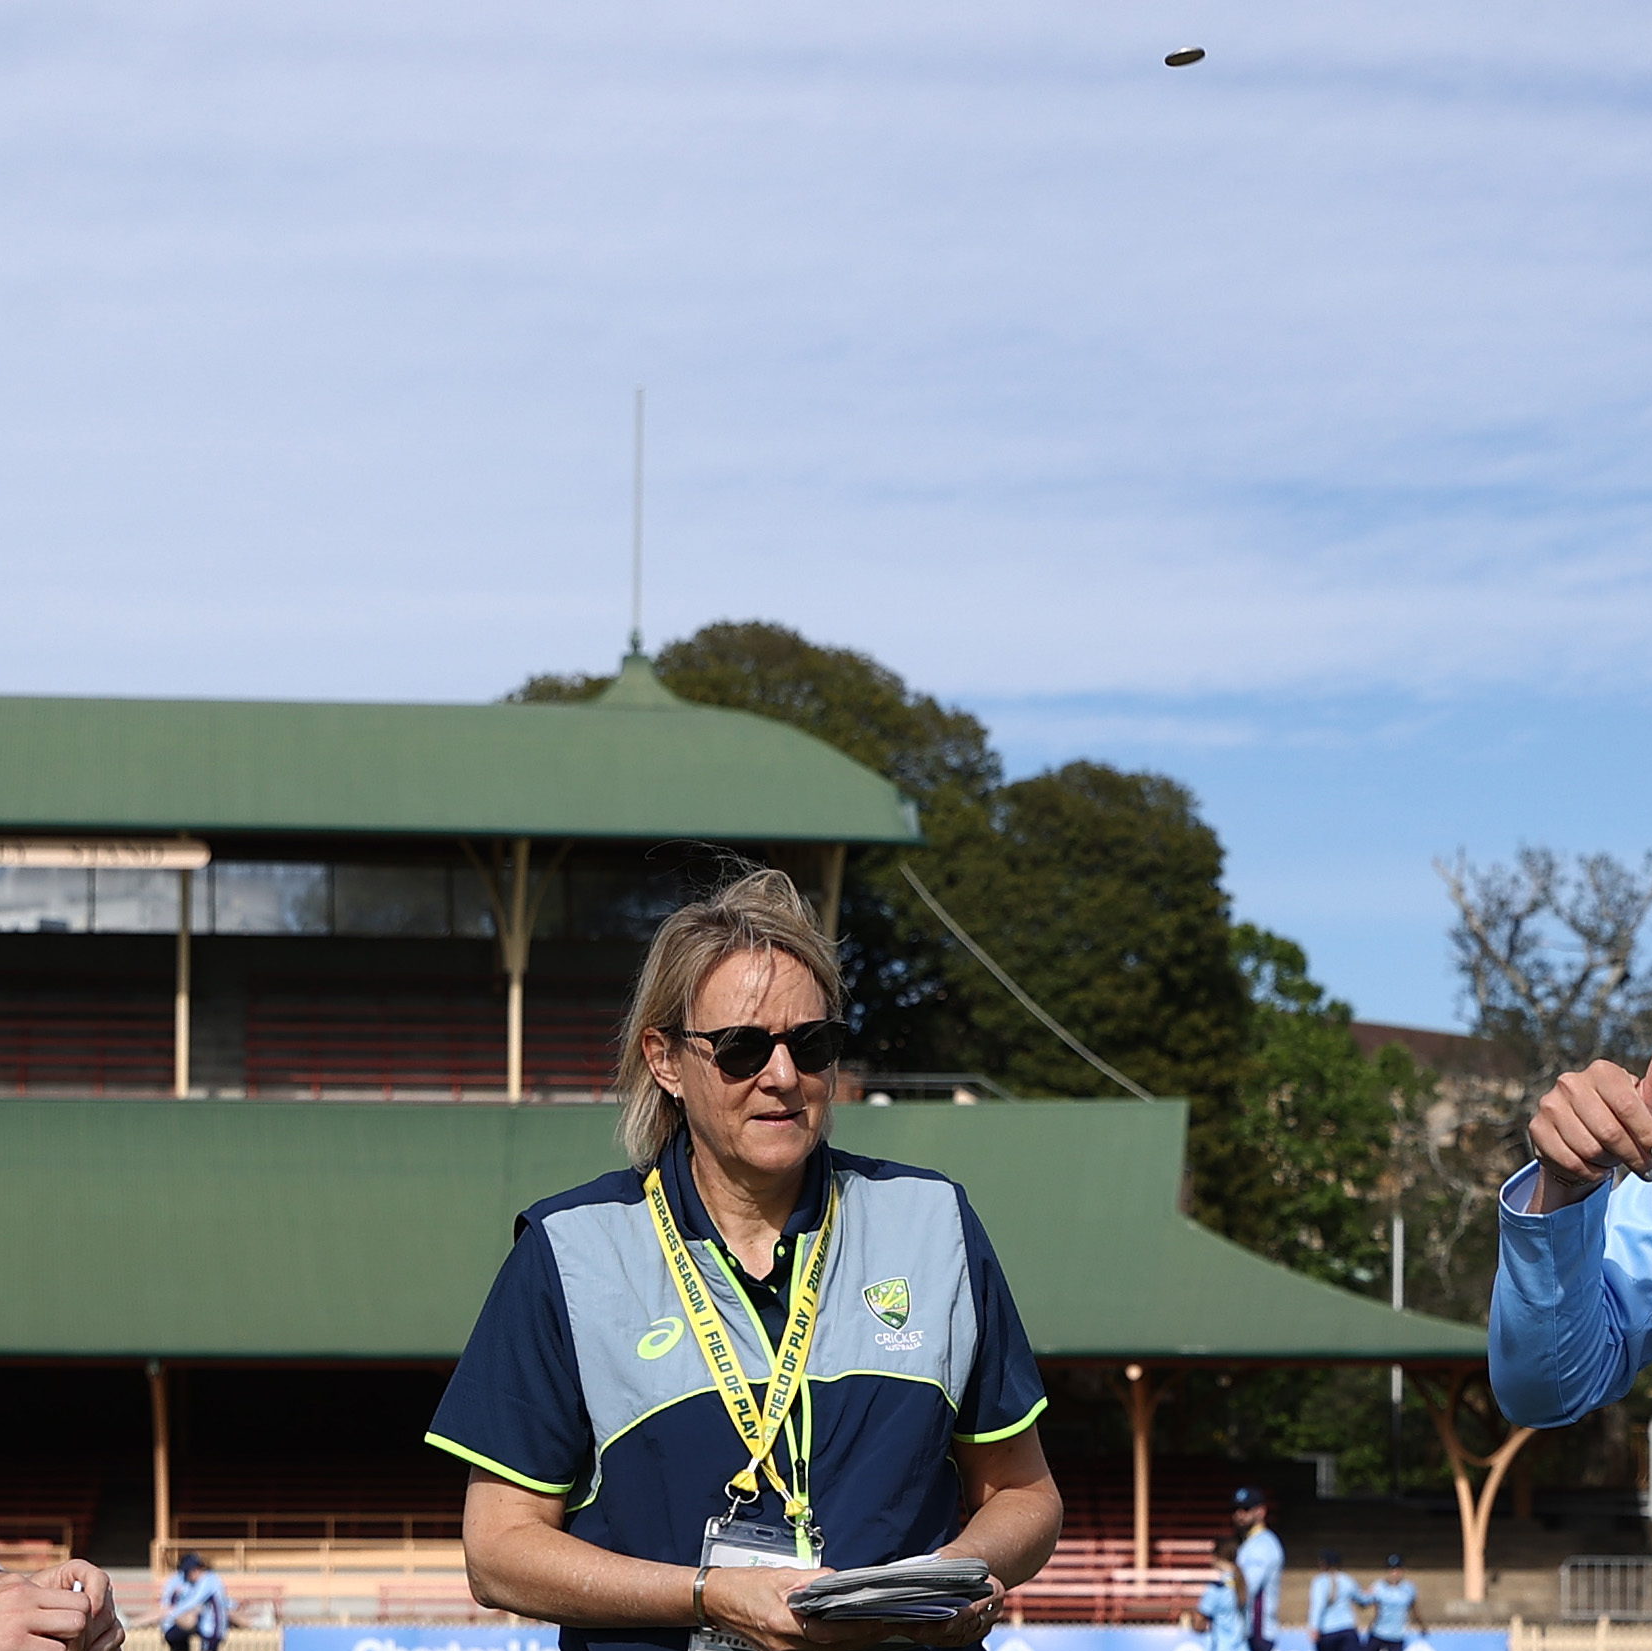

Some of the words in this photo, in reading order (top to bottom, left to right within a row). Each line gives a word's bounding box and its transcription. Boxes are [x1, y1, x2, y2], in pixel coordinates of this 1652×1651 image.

[674, 1252, 707, 1314] SEASON
[788, 1307, 810, 1350] PLAY
[875, 1330, 924, 1345] CRICKET
[705, 1330, 733, 1373] FIELD
[781, 1349, 798, 1373] OF
[724, 1374, 743, 1395] OF
[768, 1373, 792, 1420] FIELD
[733, 1397, 760, 1440] PLAY
